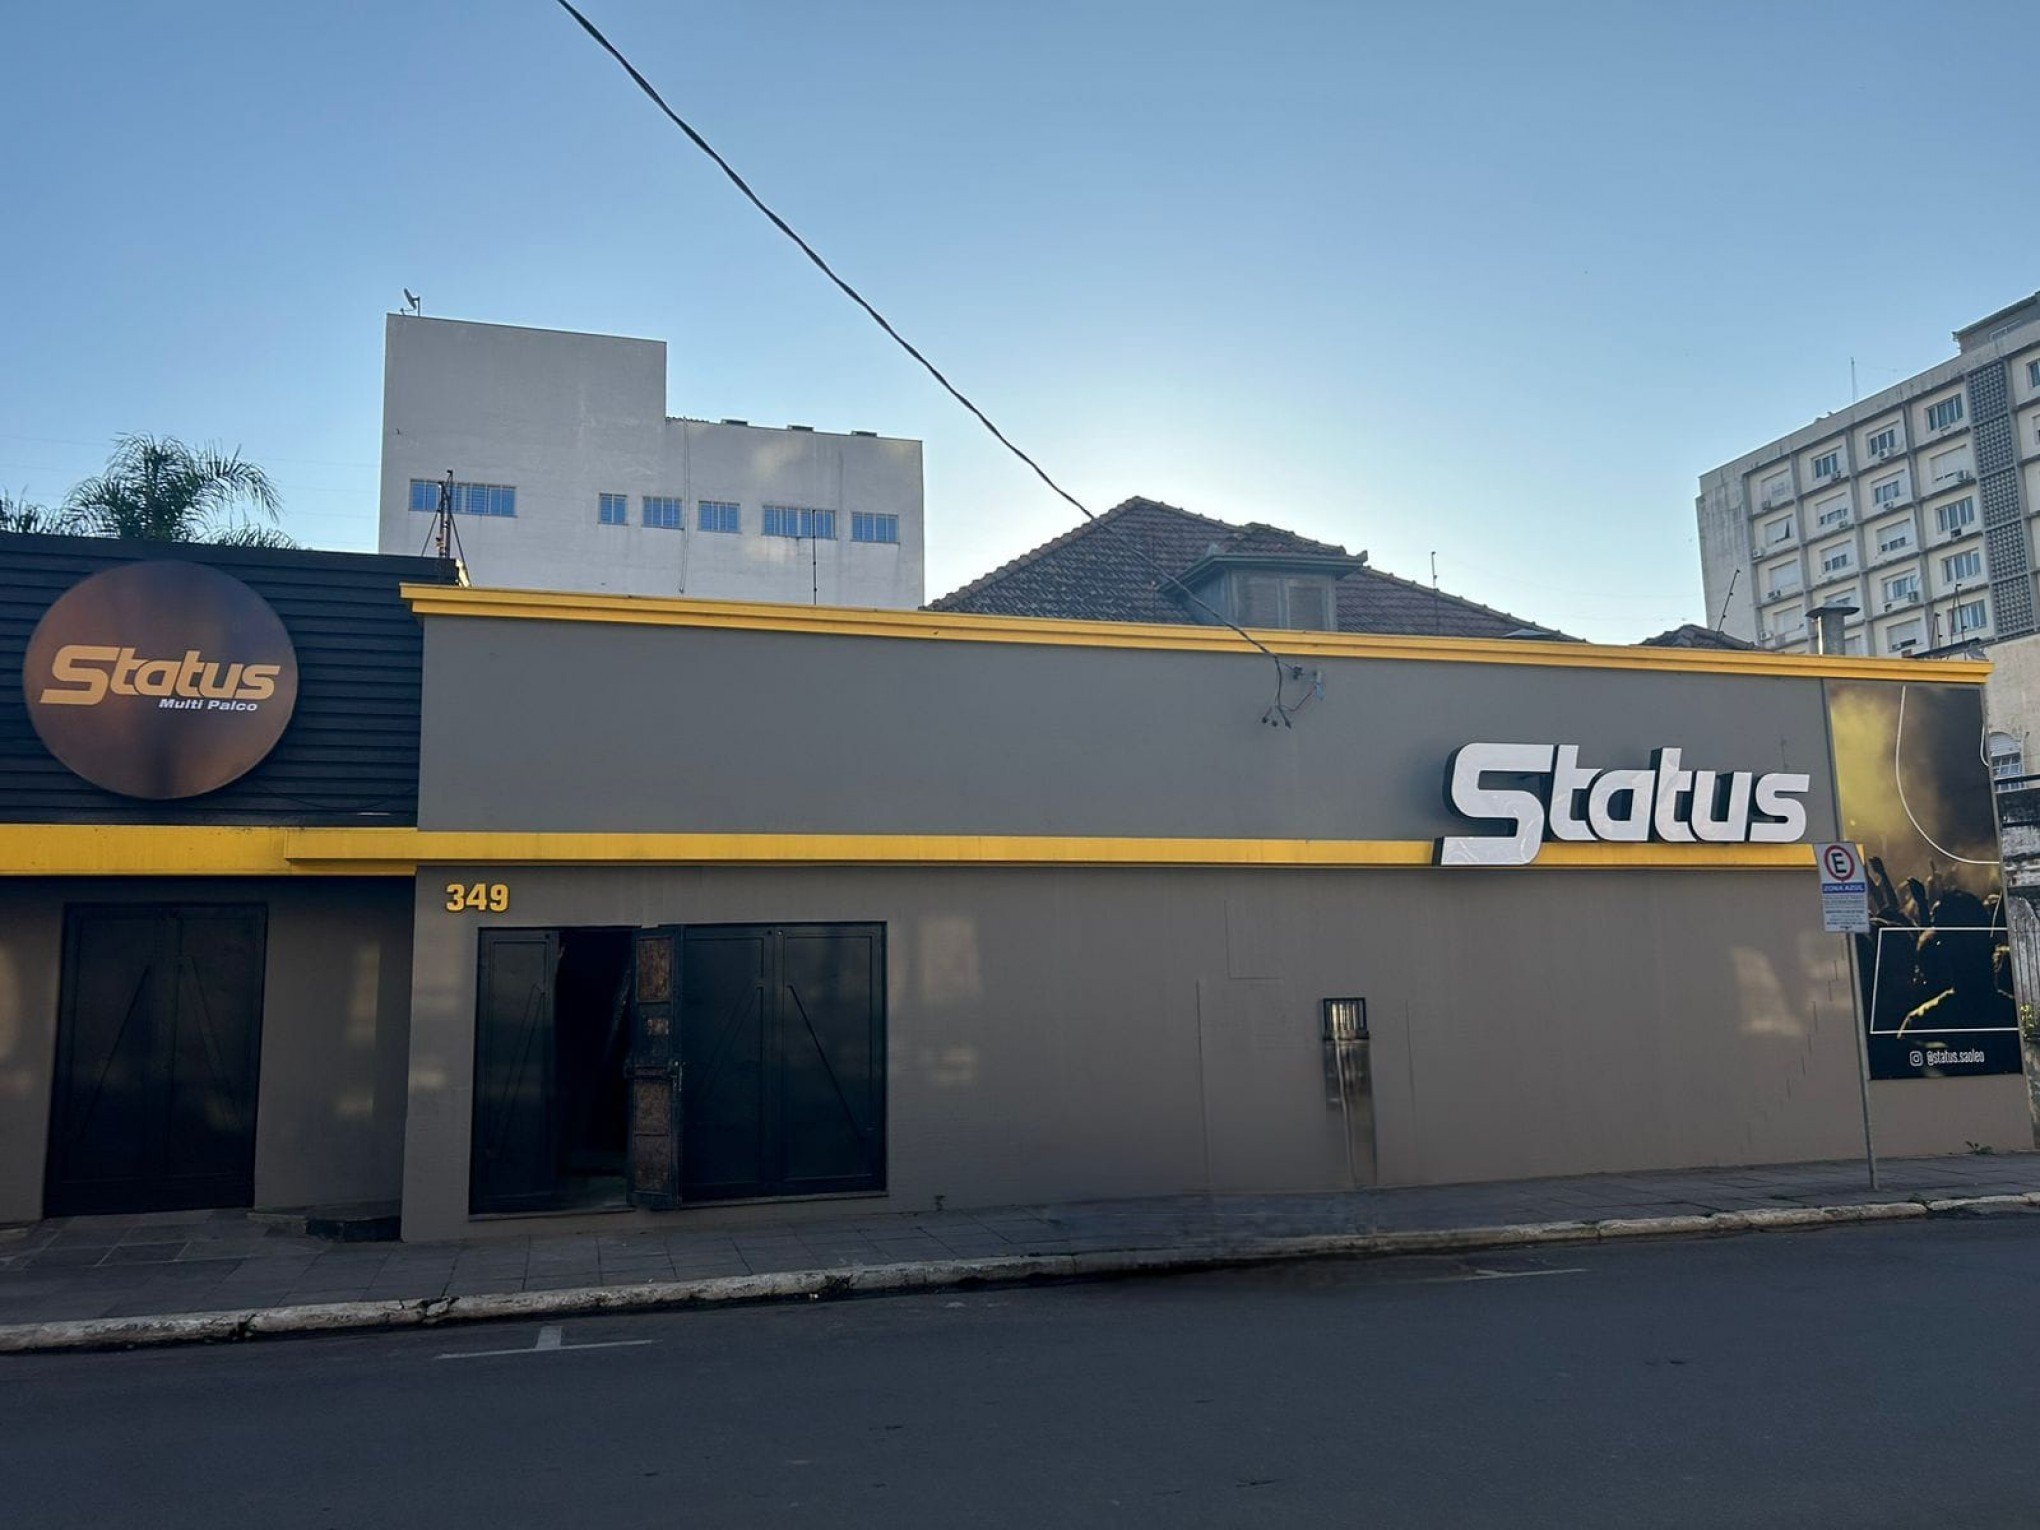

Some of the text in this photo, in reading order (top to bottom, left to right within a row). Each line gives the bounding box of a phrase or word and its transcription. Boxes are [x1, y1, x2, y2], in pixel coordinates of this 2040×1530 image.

[40, 644, 281, 706] Status
[158, 698, 259, 712] Multi Palco
[1436, 742, 1811, 866] Status
[1830, 852, 1848, 874] E
[445, 882, 509, 912] 349
